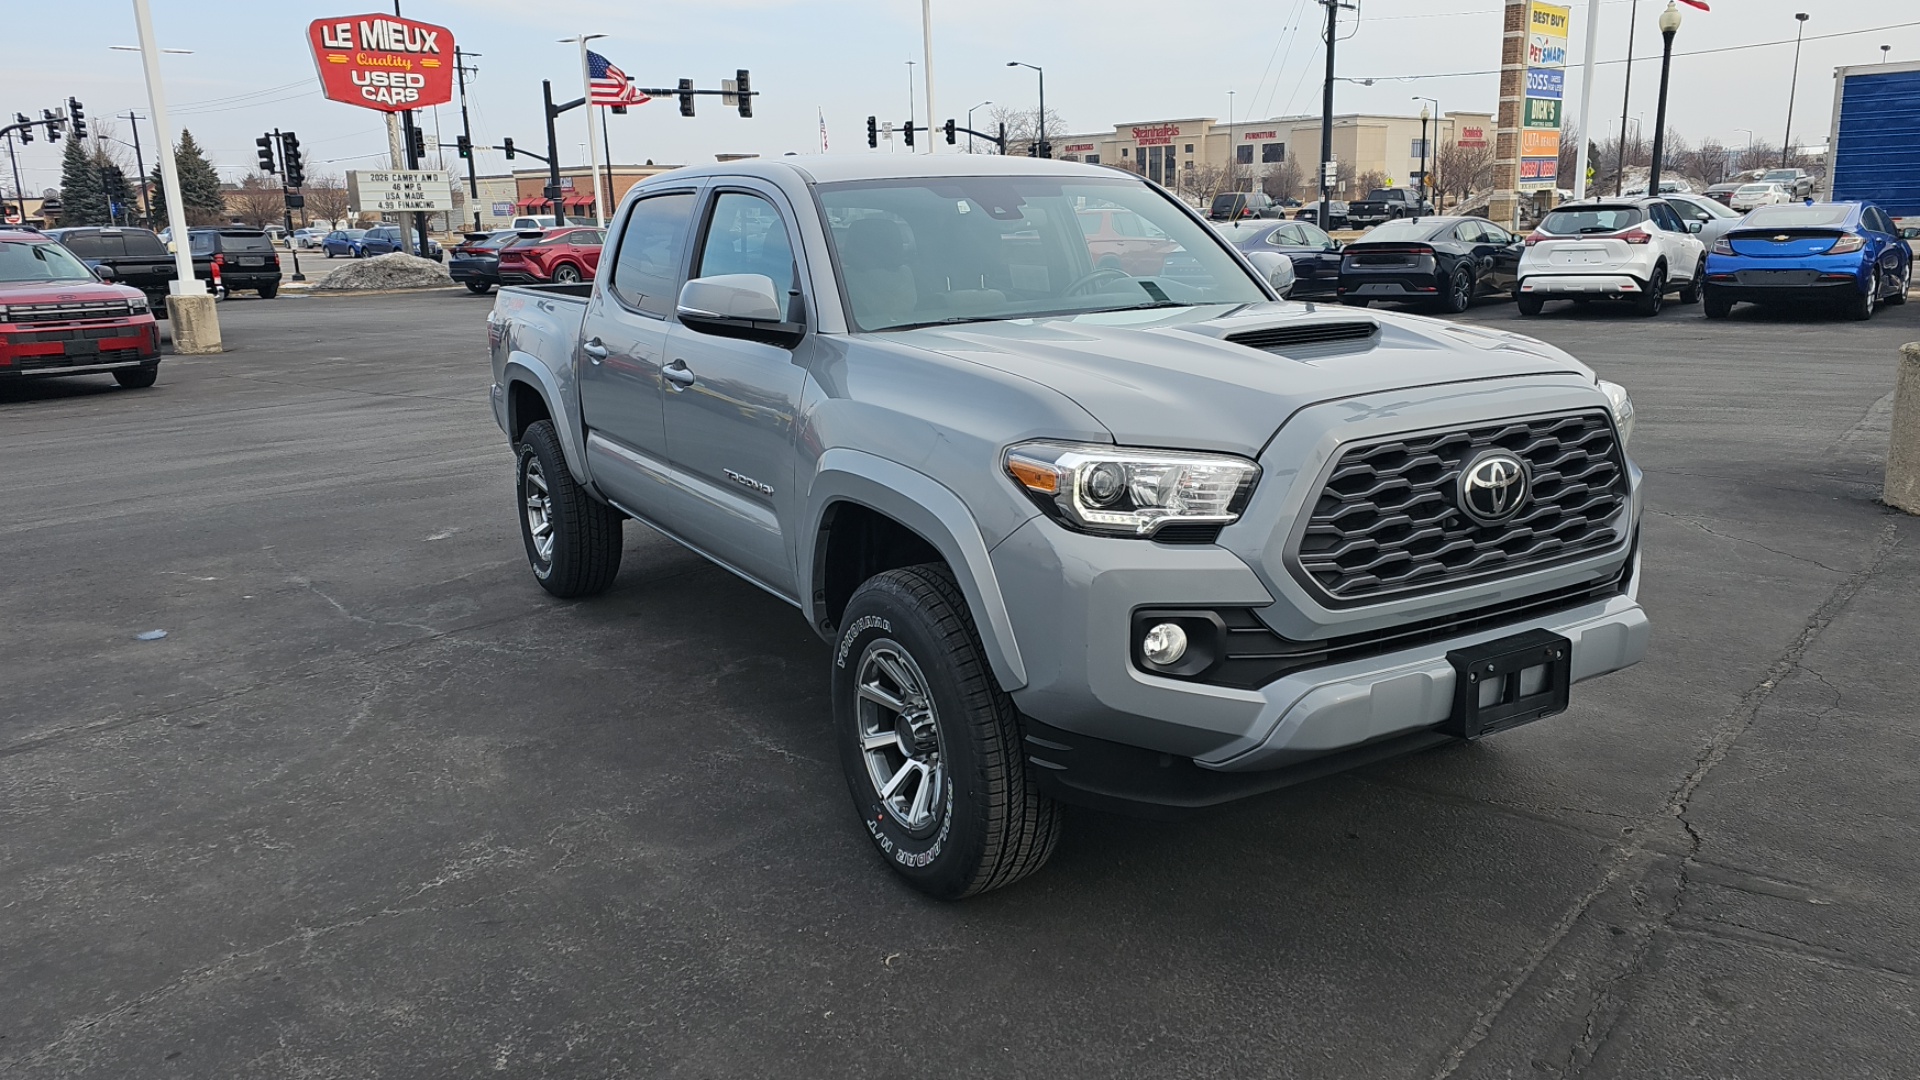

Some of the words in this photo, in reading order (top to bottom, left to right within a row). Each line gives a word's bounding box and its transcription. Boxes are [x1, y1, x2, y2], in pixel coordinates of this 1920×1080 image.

[1533, 10, 1550, 24] BEST
[1551, 14, 1566, 28] BUY
[322, 22, 354, 49] LE
[359, 19, 440, 53] MIEUX
[356, 53, 412, 71] Quality
[351, 70, 426, 88] USED
[1527, 73, 1549, 90] ROSS
[361, 87, 420, 105] CARS
[1531, 99, 1555, 120] DICK'S
[1132, 123, 1180, 138] Steinhafels
[1245, 131, 1277, 140] FURNITURE
[1524, 133, 1540, 147] ULTA
[370, 173, 389, 182] 2026
[392, 173, 418, 182] CAMRY
[392, 183, 401, 191] 46
[385, 192, 401, 200] USA
[404, 192, 425, 200] MADE
[377, 201, 395, 210] 4.99
[398, 201, 435, 209] FINANCING
[723, 467, 775, 494] TACOMA
[837, 615, 892, 669] YOKOHAMA
